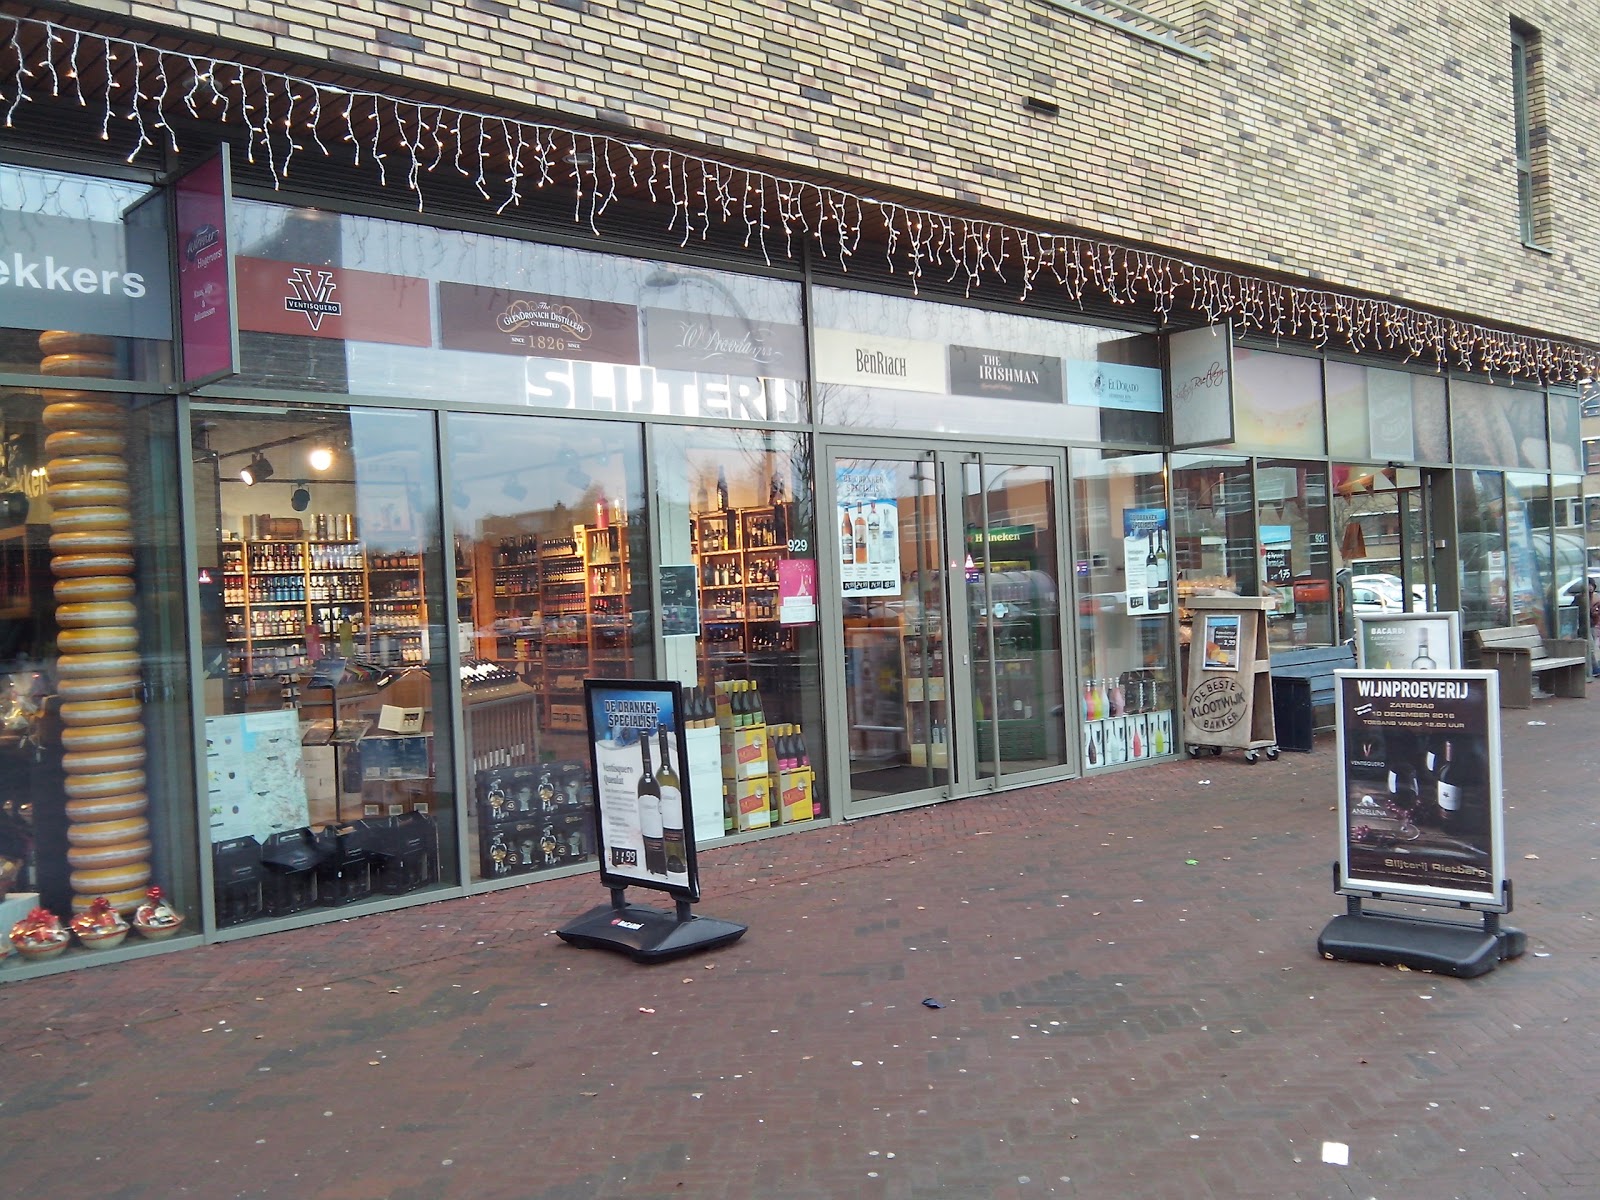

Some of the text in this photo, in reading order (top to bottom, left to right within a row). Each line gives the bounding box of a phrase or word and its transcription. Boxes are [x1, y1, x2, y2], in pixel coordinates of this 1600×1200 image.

[288, 300, 338, 312] VENTISQUERO
[550, 311, 585, 333] DISTILLERY
[528, 335, 565, 351] 1826
[982, 354, 1001, 366] THE
[979, 365, 1039, 384] IRISHMAN
[975, 532, 1021, 542] Hineken
[787, 539, 808, 552] 929
[1370, 627, 1406, 635] BACARDI
[1194, 680, 1236, 703] DE BESTE
[1357, 680, 1469, 699] WIJNPROEVERIJ
[604, 699, 616, 713] DE
[1190, 691, 1246, 719] KLOOTWIJK
[608, 713, 657, 728] SPECIALIST
[1203, 712, 1239, 730] BAKKER
